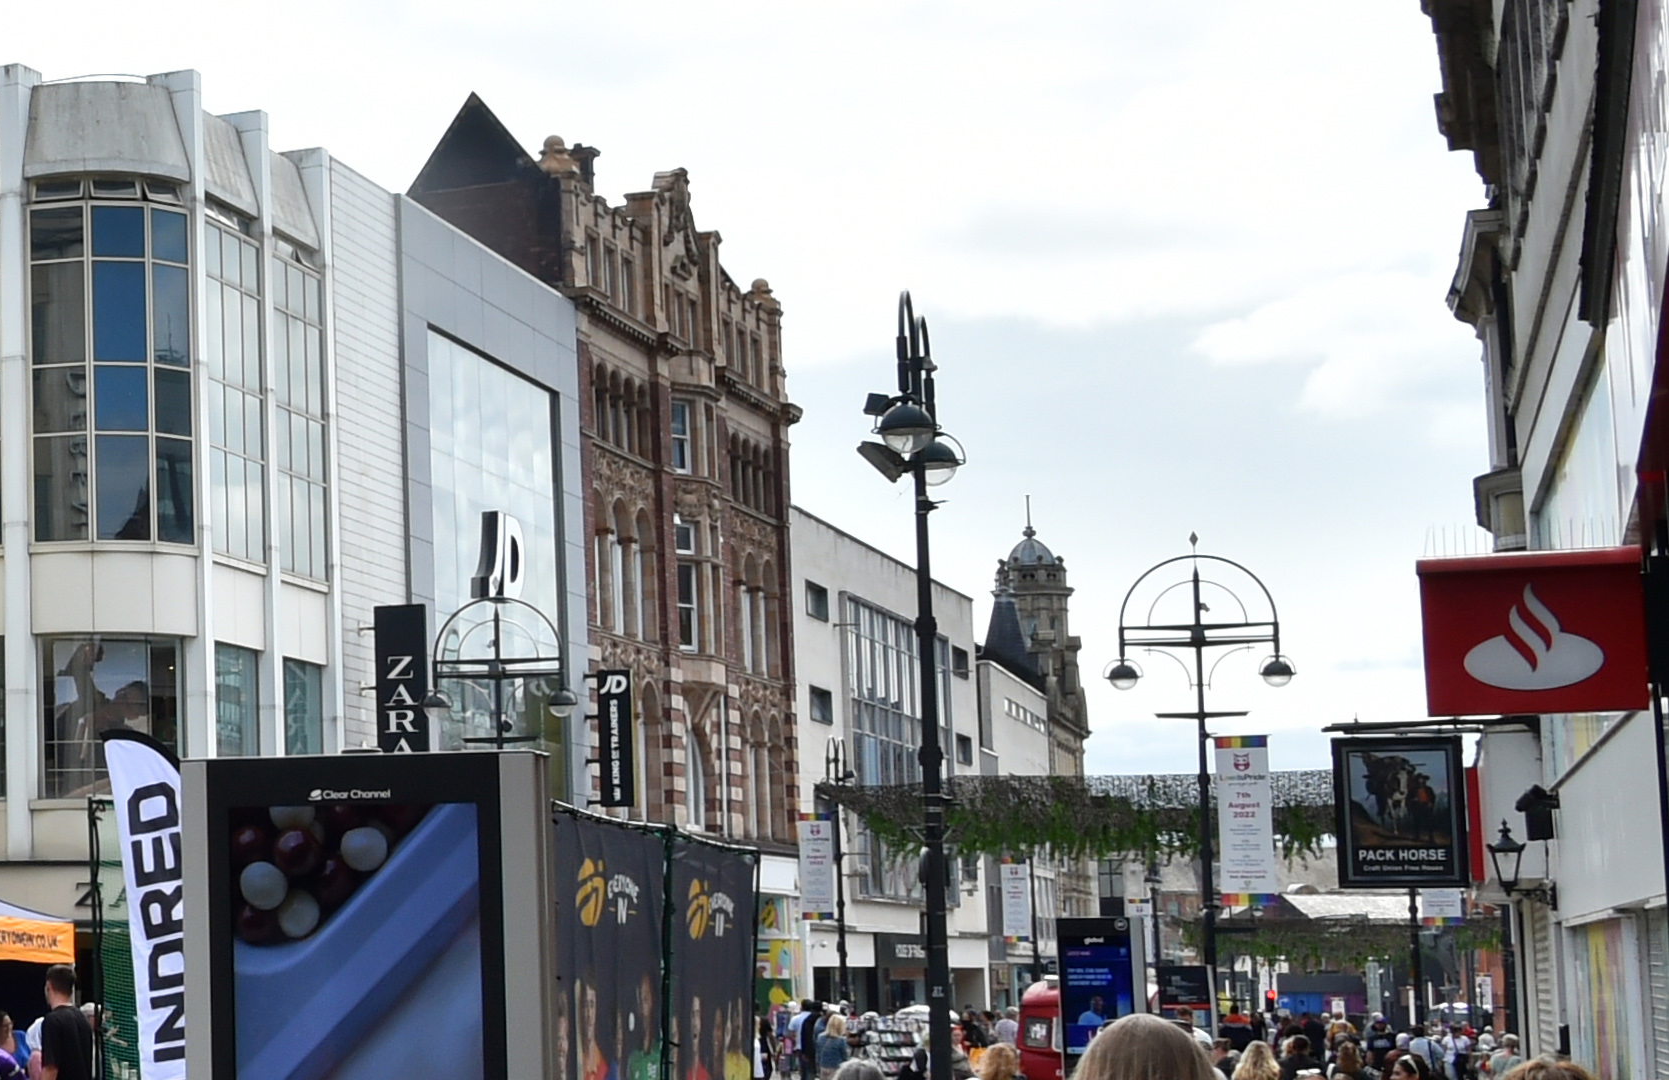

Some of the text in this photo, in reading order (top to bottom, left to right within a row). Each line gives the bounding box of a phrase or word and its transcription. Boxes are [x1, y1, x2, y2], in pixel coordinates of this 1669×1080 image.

[471, 510, 525, 599] JD
[599, 675, 628, 695] JD
[385, 655, 419, 753] ZARA
[609, 699, 619, 748] TRAINERS
[611, 760, 620, 785] KING
[323, 788, 391, 799] Clear Channel
[1228, 802, 1260, 810] August
[1359, 849, 1447, 861] PACK HORSE
